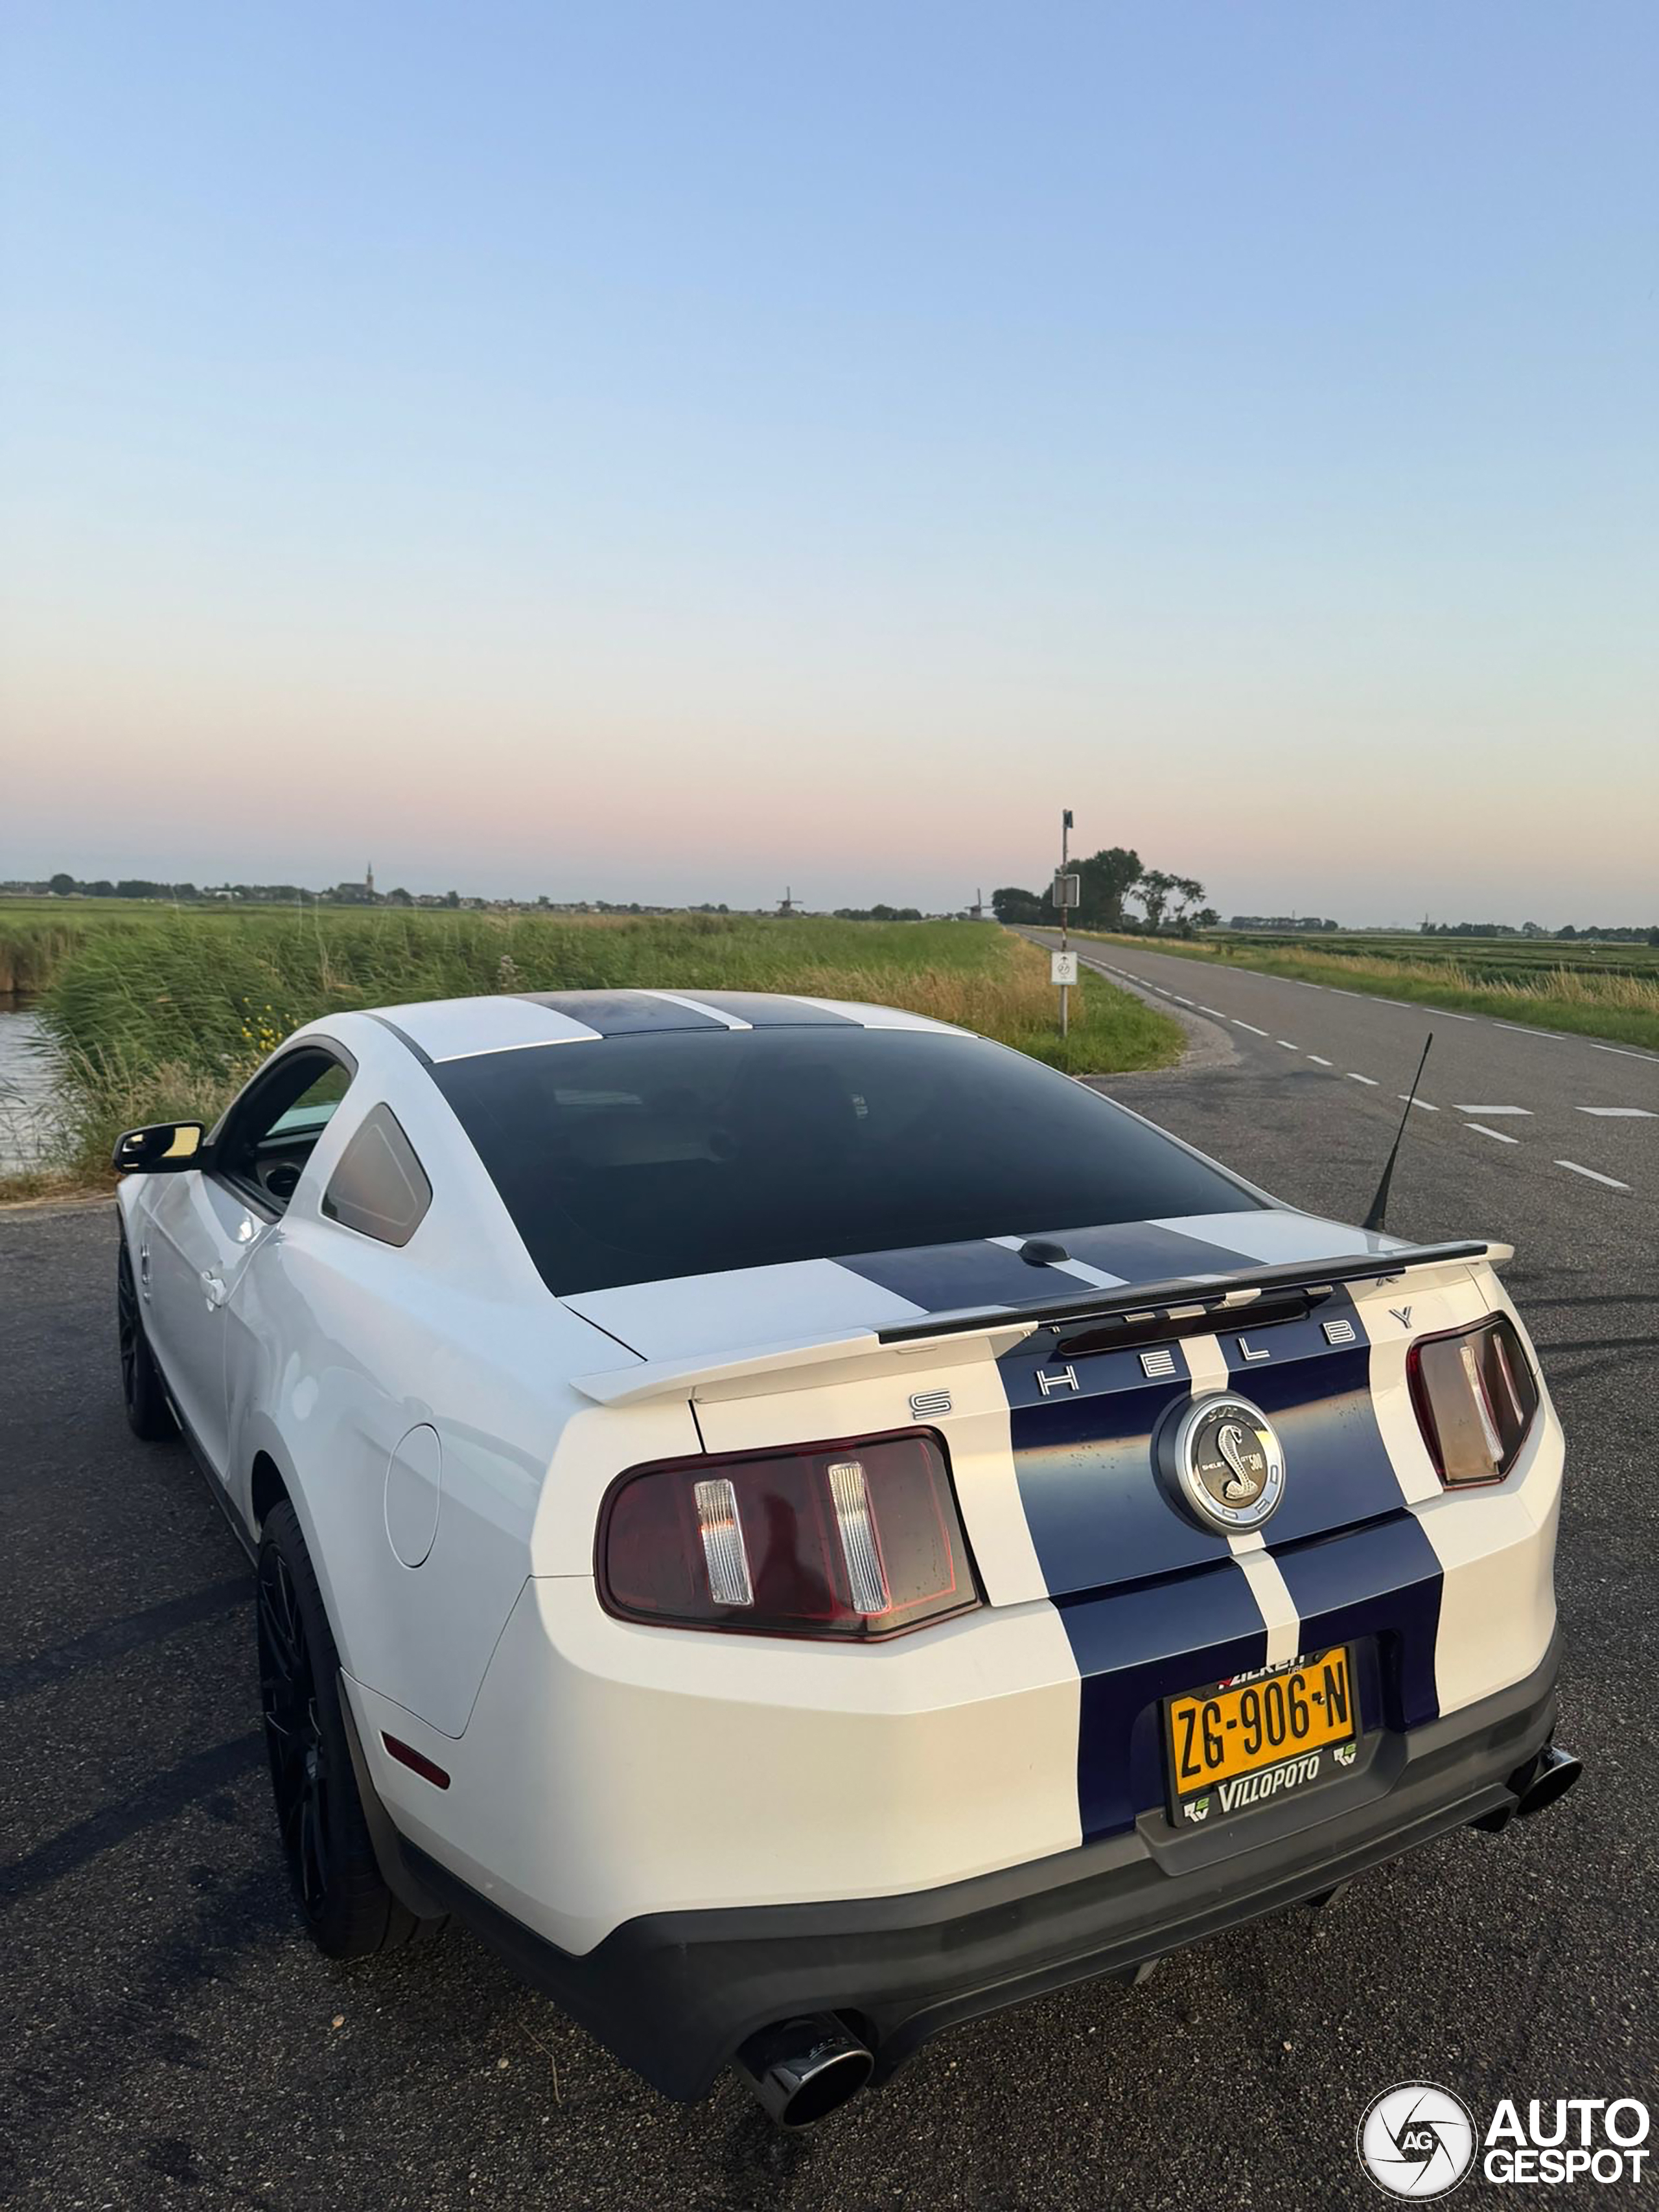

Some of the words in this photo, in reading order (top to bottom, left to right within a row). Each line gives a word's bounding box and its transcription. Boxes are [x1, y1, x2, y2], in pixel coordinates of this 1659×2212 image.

[909, 1306, 1413, 1420] SHELBY
[1178, 1661, 1348, 1779] ZG-906-N
[1218, 1752, 1321, 1813] VILLOPOTO
